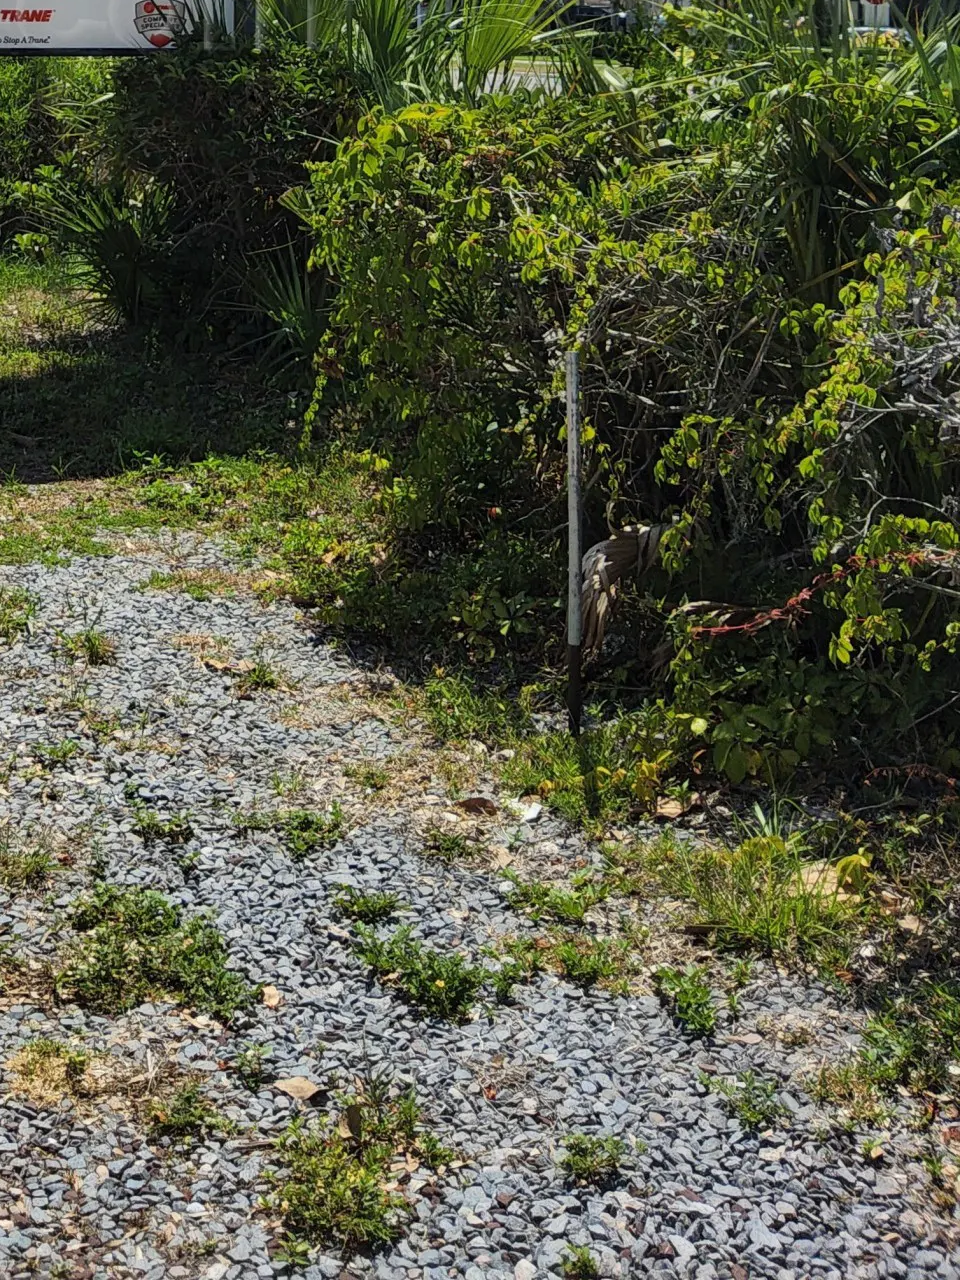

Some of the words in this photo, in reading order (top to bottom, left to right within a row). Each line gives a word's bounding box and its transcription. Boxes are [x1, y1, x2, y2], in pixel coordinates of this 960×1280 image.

[0, 9, 53, 23] TRANE
[3, 35, 20, 46] Stop
[21, 36, 28, 44] A
